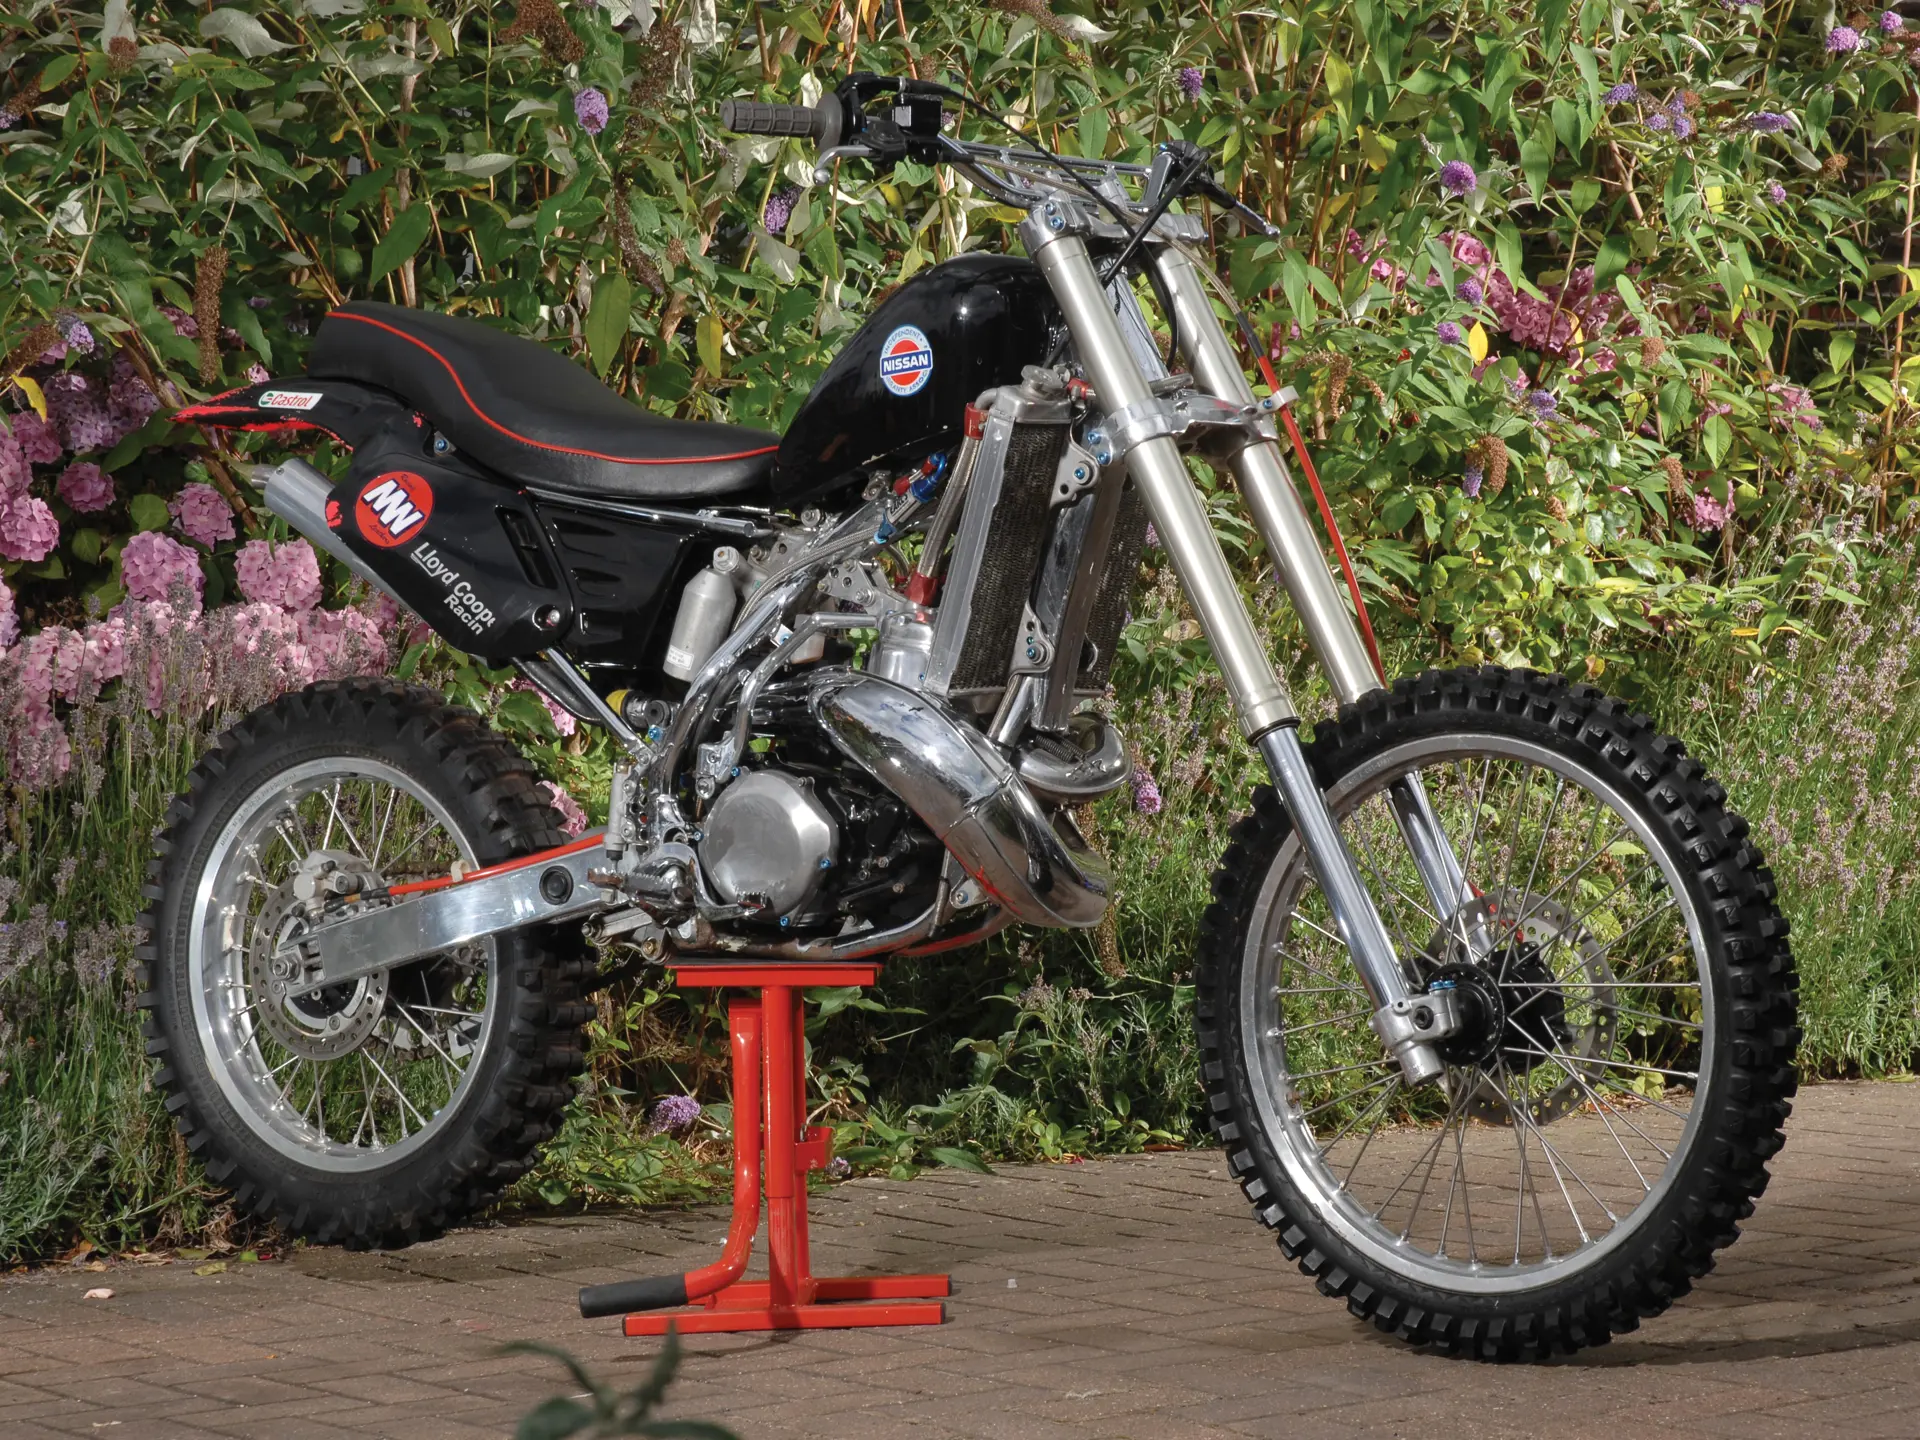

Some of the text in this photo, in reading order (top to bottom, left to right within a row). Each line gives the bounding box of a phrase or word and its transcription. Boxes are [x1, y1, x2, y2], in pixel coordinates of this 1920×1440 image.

[885, 328, 921, 354] INDEPENDENT
[883, 353, 929, 373] NISSAN
[271, 393, 313, 407] Castrol
[410, 541, 460, 585] Lloyd
[443, 593, 484, 635] Racin
